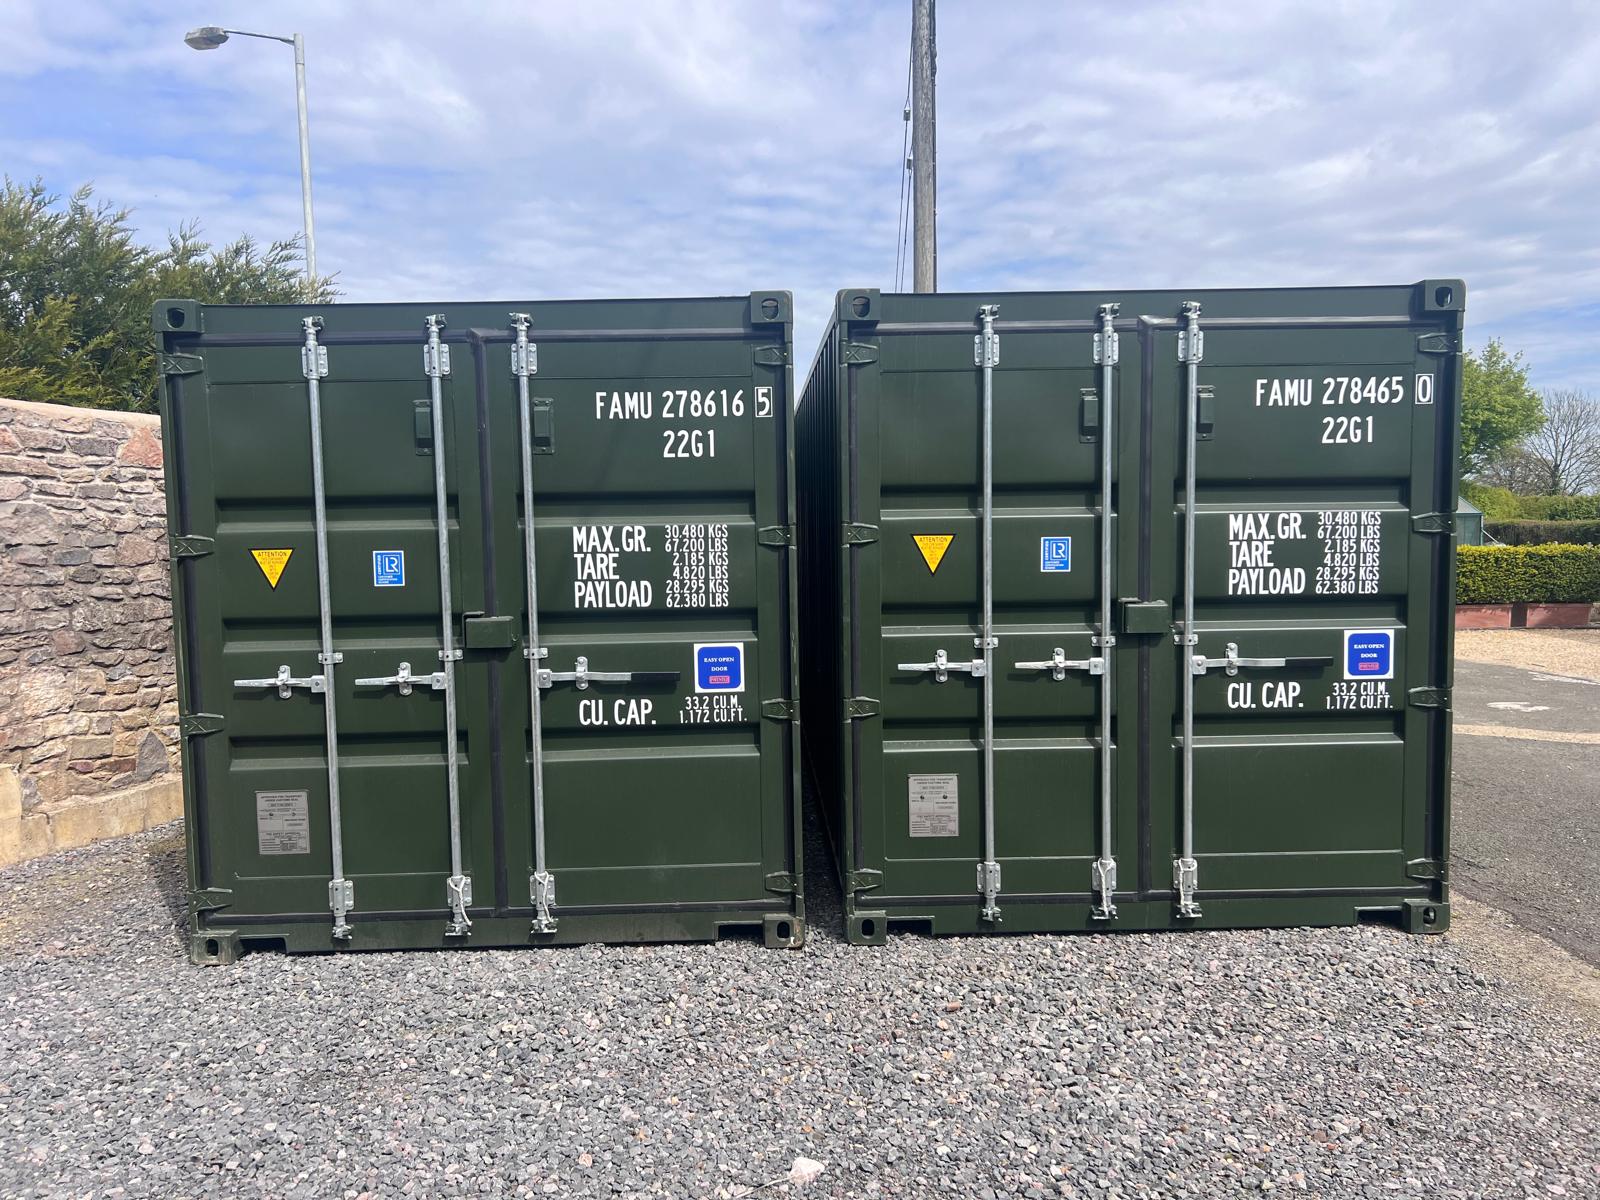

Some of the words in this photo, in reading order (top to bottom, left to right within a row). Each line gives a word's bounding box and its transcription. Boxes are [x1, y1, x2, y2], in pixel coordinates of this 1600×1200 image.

[1255, 379, 1312, 406] FAMU
[1322, 376, 1404, 404] 278465
[1417, 375, 1432, 403] 0
[595, 391, 652, 419] FAMU
[662, 389, 744, 418] 278616
[757, 388, 771, 416] 5
[1321, 415, 1373, 444] 22G1
[663, 429, 715, 458] 22G1
[1361, 511, 1381, 525] KGS
[708, 524, 728, 538] KGS
[1360, 525, 1380, 539] LBS
[708, 538, 728, 552] LBS
[1053, 543, 1065, 558] LR
[1229, 540, 1275, 567] TARE
[1360, 539, 1380, 552] KGS
[385, 556, 398, 572] LR
[573, 553, 620, 580] TARE
[708, 552, 729, 565] KGS
[1360, 553, 1380, 566] LBS
[708, 565, 729, 579] LBS
[1228, 567, 1306, 595] PAYLOAD
[1359, 566, 1380, 580] KGS
[574, 580, 653, 608] PAYLOAD
[709, 579, 729, 593] KGS
[1358, 580, 1379, 594] LBS
[709, 593, 729, 607] LBS
[1227, 682, 1256, 709] CU.
[1261, 681, 1304, 708] CAP.
[1332, 682, 1357, 696] 33.2
[579, 699, 609, 725] CU.
[613, 698, 657, 725] CAP.
[685, 696, 709, 710] 33.2
